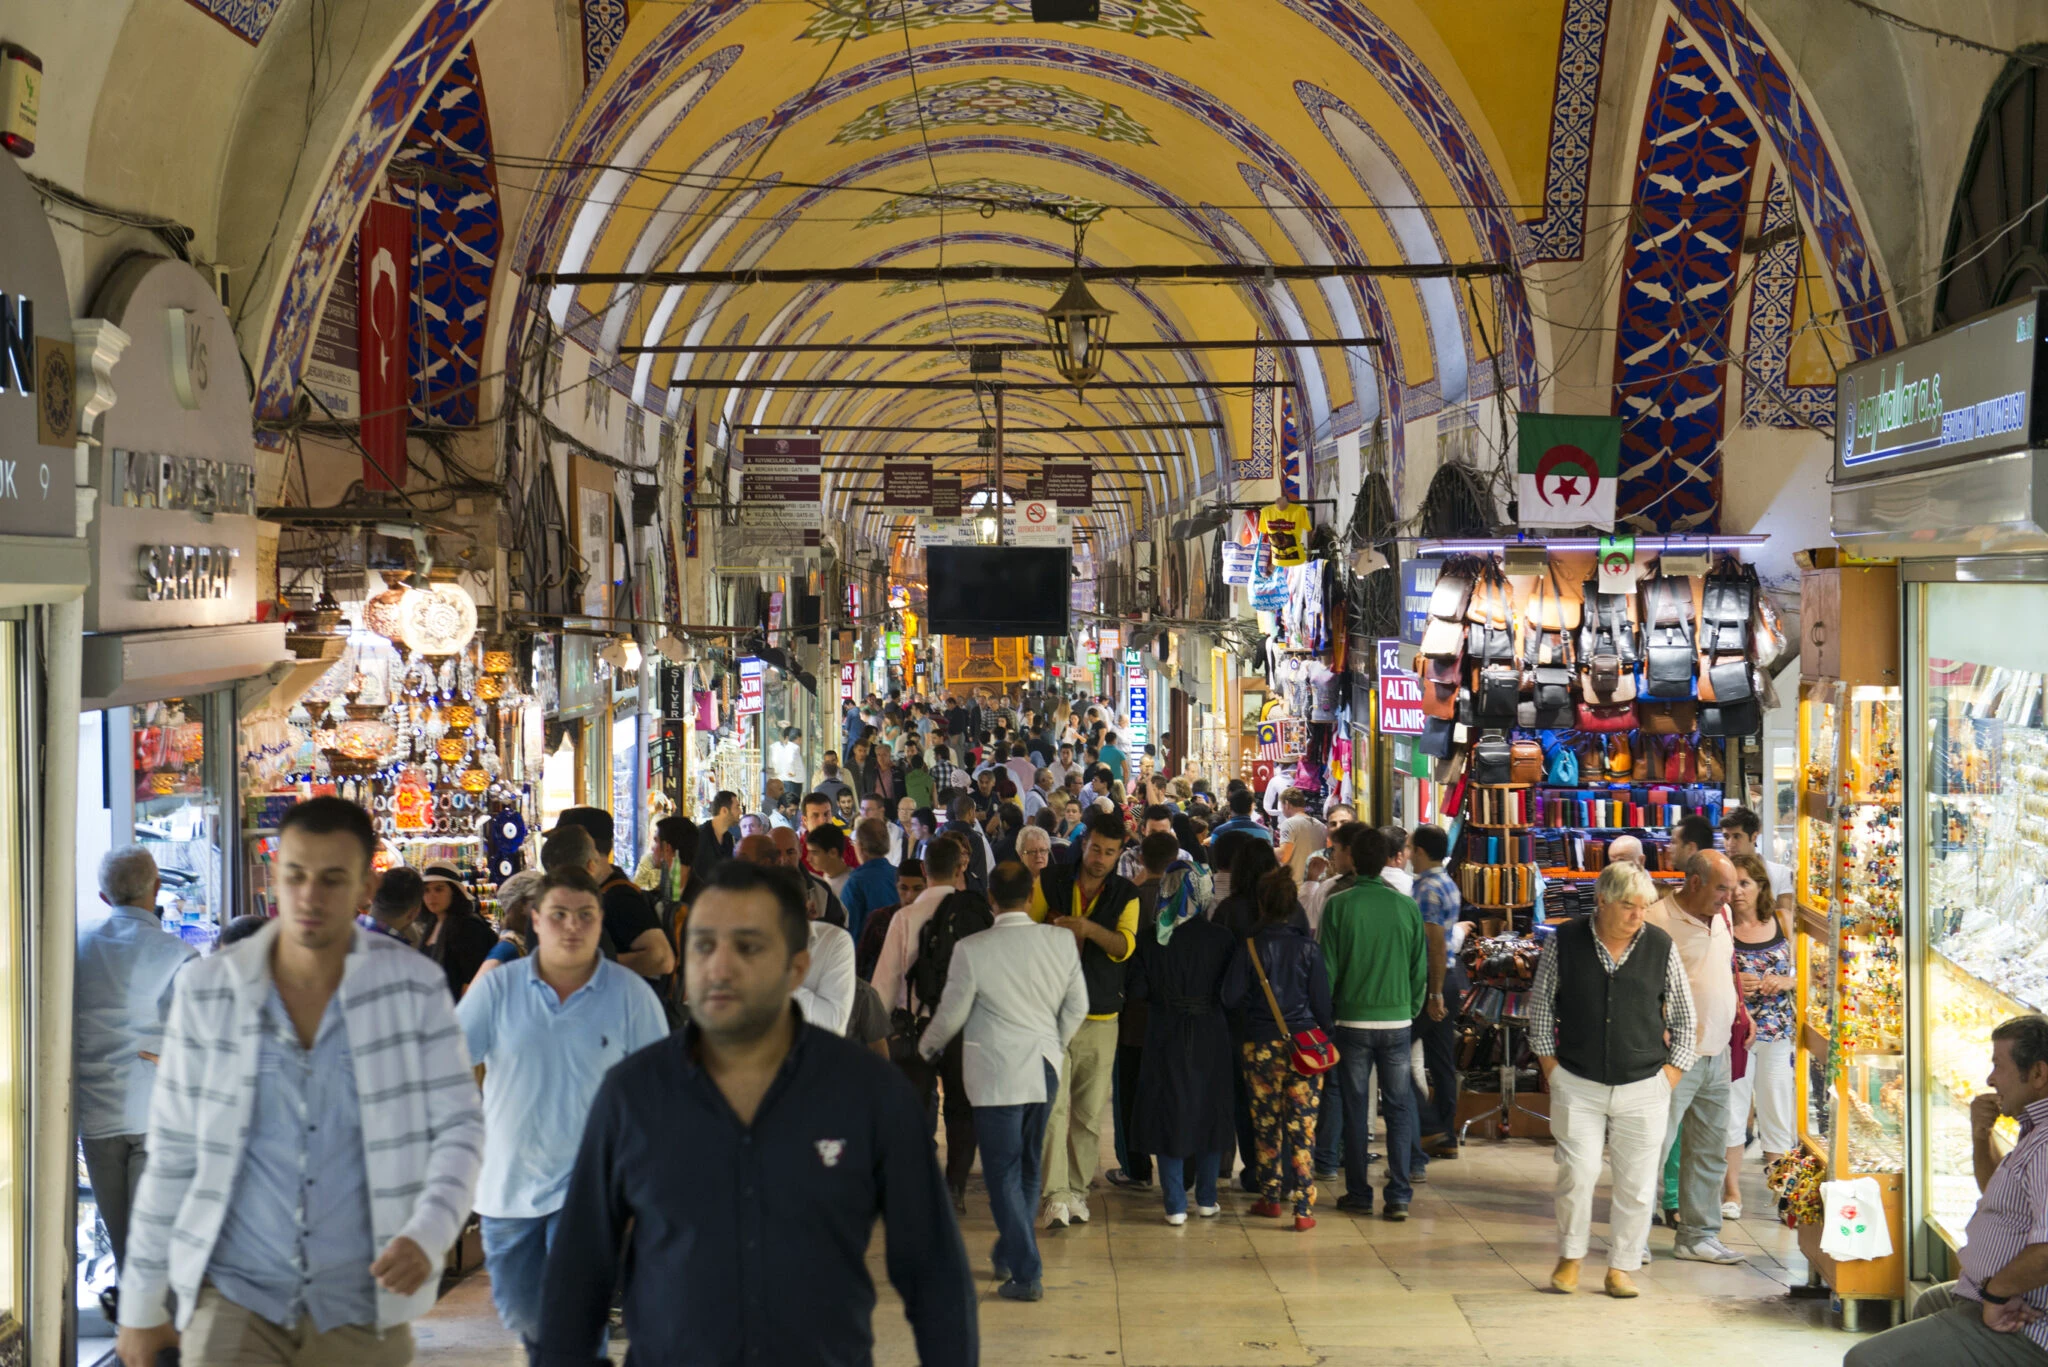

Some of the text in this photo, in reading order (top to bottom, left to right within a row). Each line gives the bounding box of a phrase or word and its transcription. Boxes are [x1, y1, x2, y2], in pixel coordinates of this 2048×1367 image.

[39, 462, 50, 501] 9
[671, 669, 680, 718] SILVER
[1386, 679, 1422, 702] ALTIN
[1384, 708, 1426, 732] ALINIR
